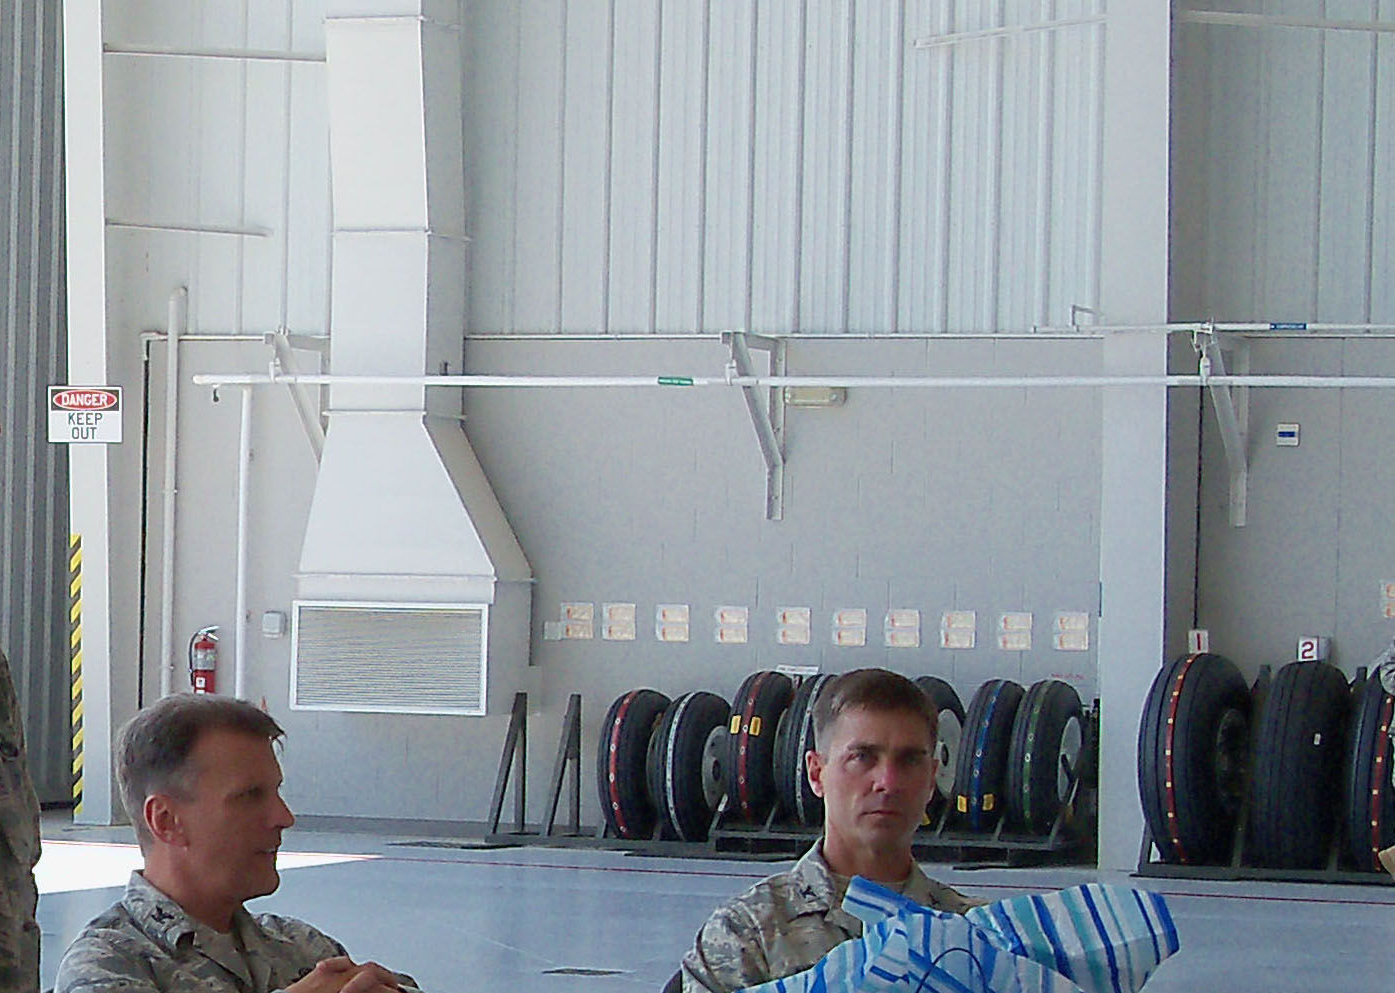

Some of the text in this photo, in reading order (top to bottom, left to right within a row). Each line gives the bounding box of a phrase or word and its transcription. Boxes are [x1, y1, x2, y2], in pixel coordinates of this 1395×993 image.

[61, 393, 108, 405] DANGER
[68, 412, 103, 425] KEEP
[71, 427, 97, 440] OUT
[1301, 641, 1315, 660] 2
